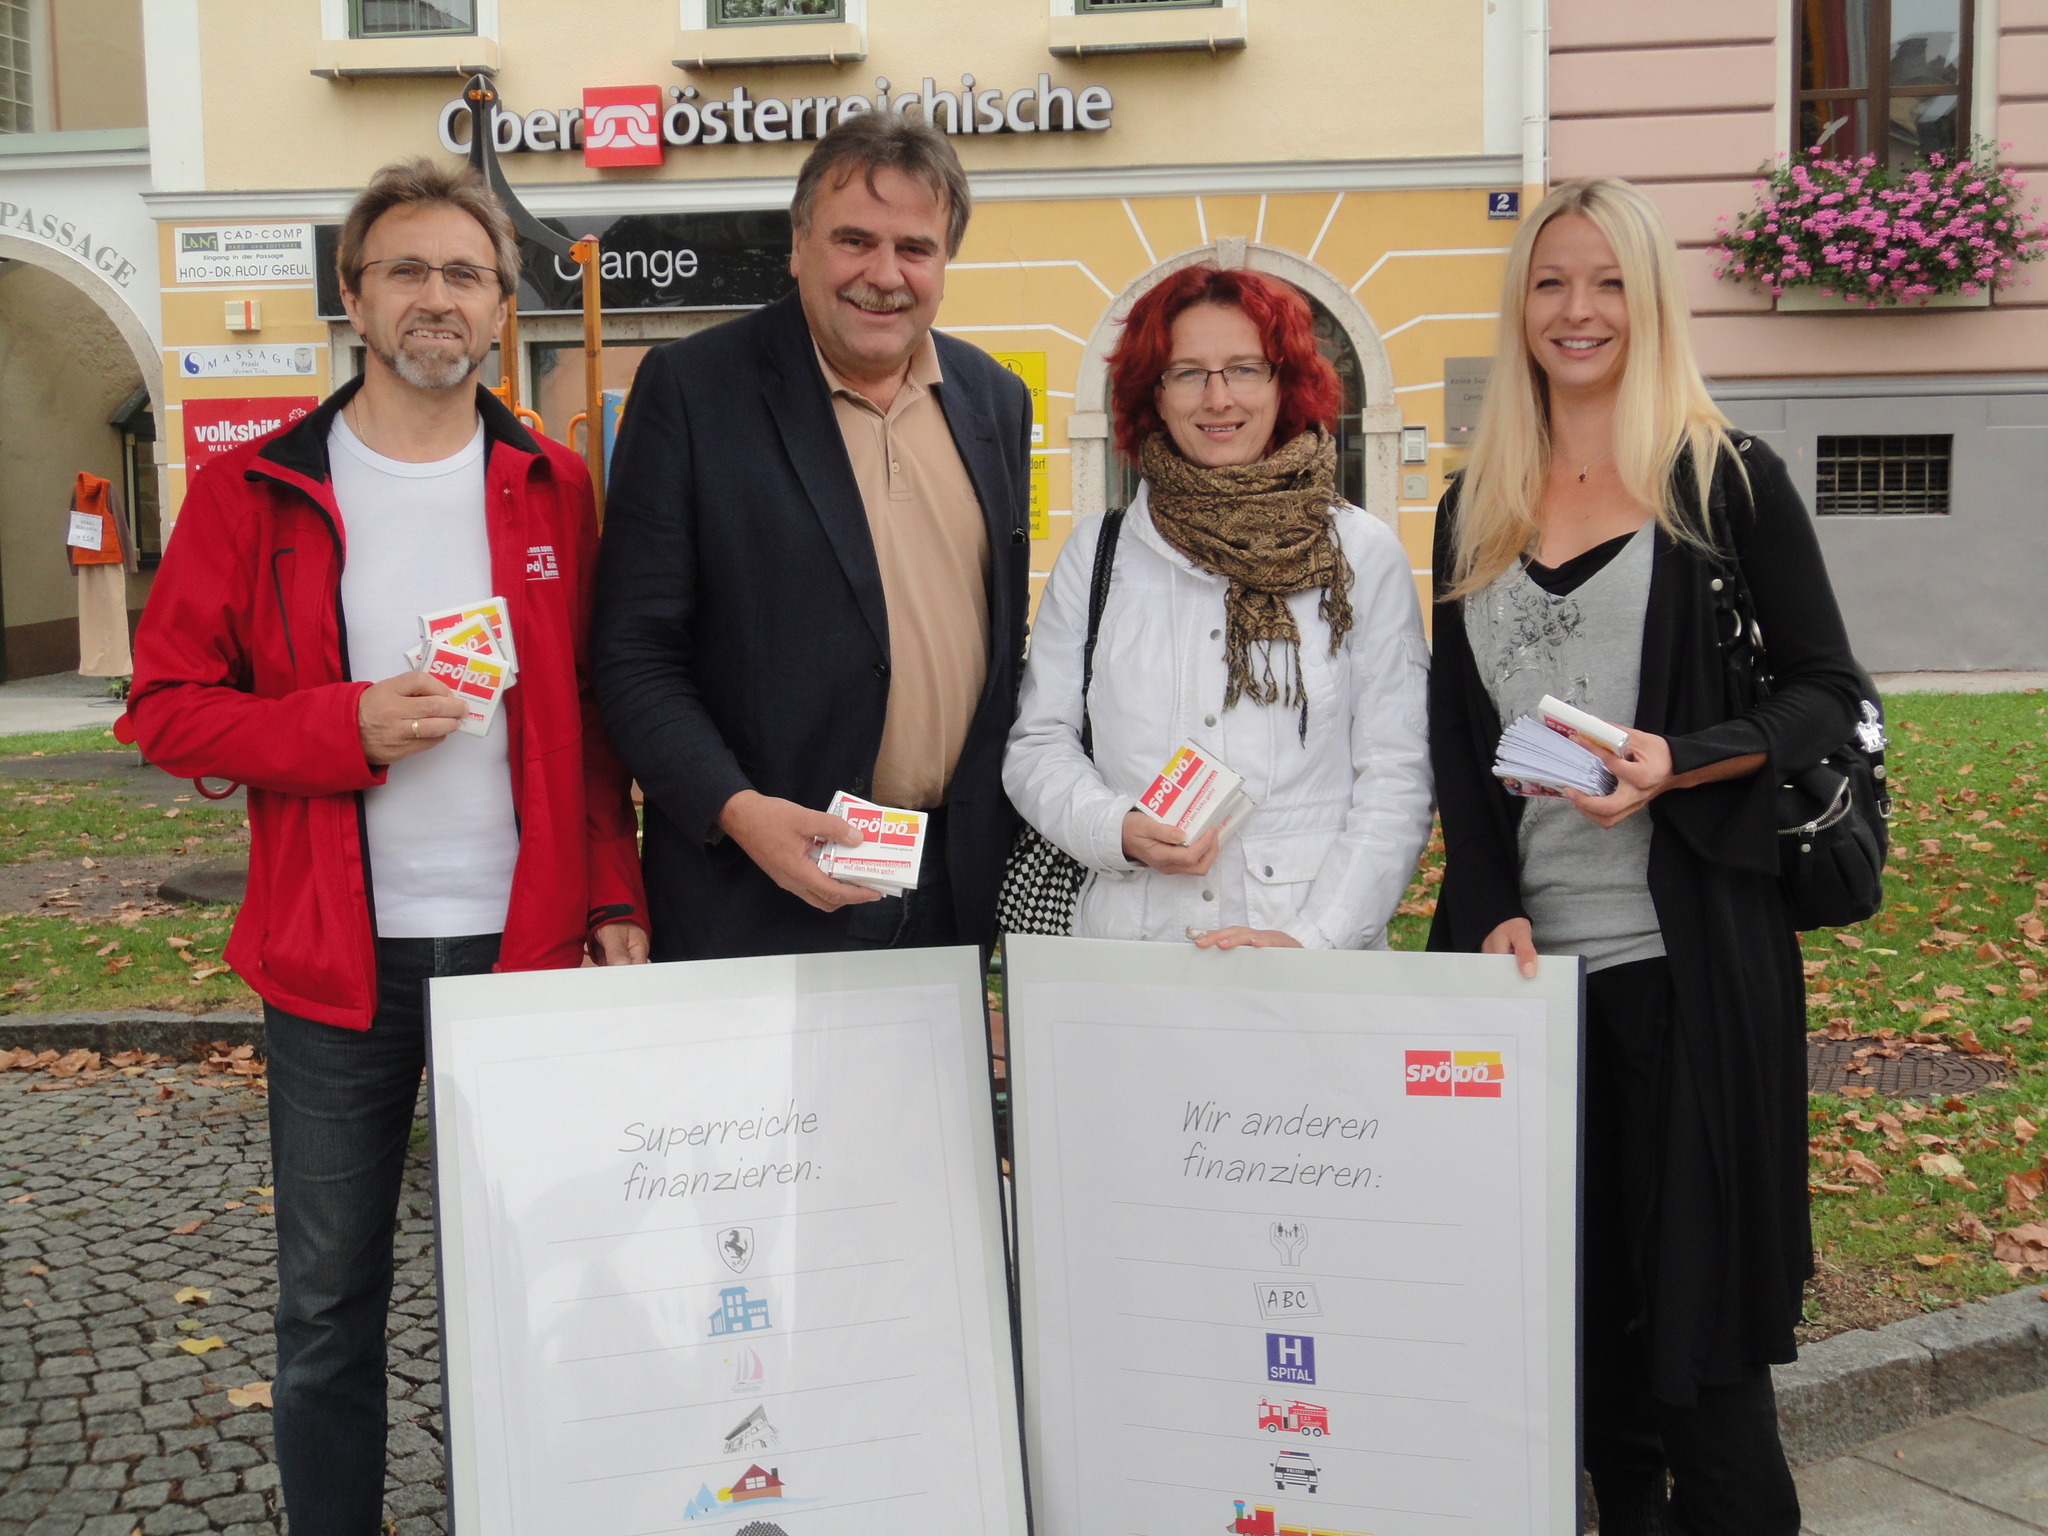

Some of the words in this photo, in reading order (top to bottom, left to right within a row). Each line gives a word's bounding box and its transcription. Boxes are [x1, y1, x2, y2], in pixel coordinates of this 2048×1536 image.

[437, 98, 583, 154] Ober
[1497, 193, 1510, 210] 2
[0, 201, 137, 288] PASSAGE
[224, 228, 303, 240] CAD-COMP
[256, 253, 284, 261] Passage
[554, 247, 698, 288] Oange
[272, 263, 310, 276] GREUL
[208, 349, 293, 370] MASSAGE
[194, 419, 282, 443] volkshilf
[430, 660, 466, 680] SPÖ
[1148, 779, 1173, 812] SPÖ
[847, 817, 881, 833] SPÖ
[880, 867, 895, 875] geht
[1406, 1061, 1452, 1083] SPÖ
[618, 1098, 818, 1157] Superreiche
[1183, 1101, 1231, 1133] Wir
[1241, 1103, 1379, 1140] anderen
[1183, 1141, 1382, 1189] finanzieren:
[624, 1157, 822, 1201] finanzieren:
[1267, 1289, 1309, 1309] ABC
[1278, 1337, 1303, 1366] H
[1270, 1366, 1313, 1382] SPITAL
